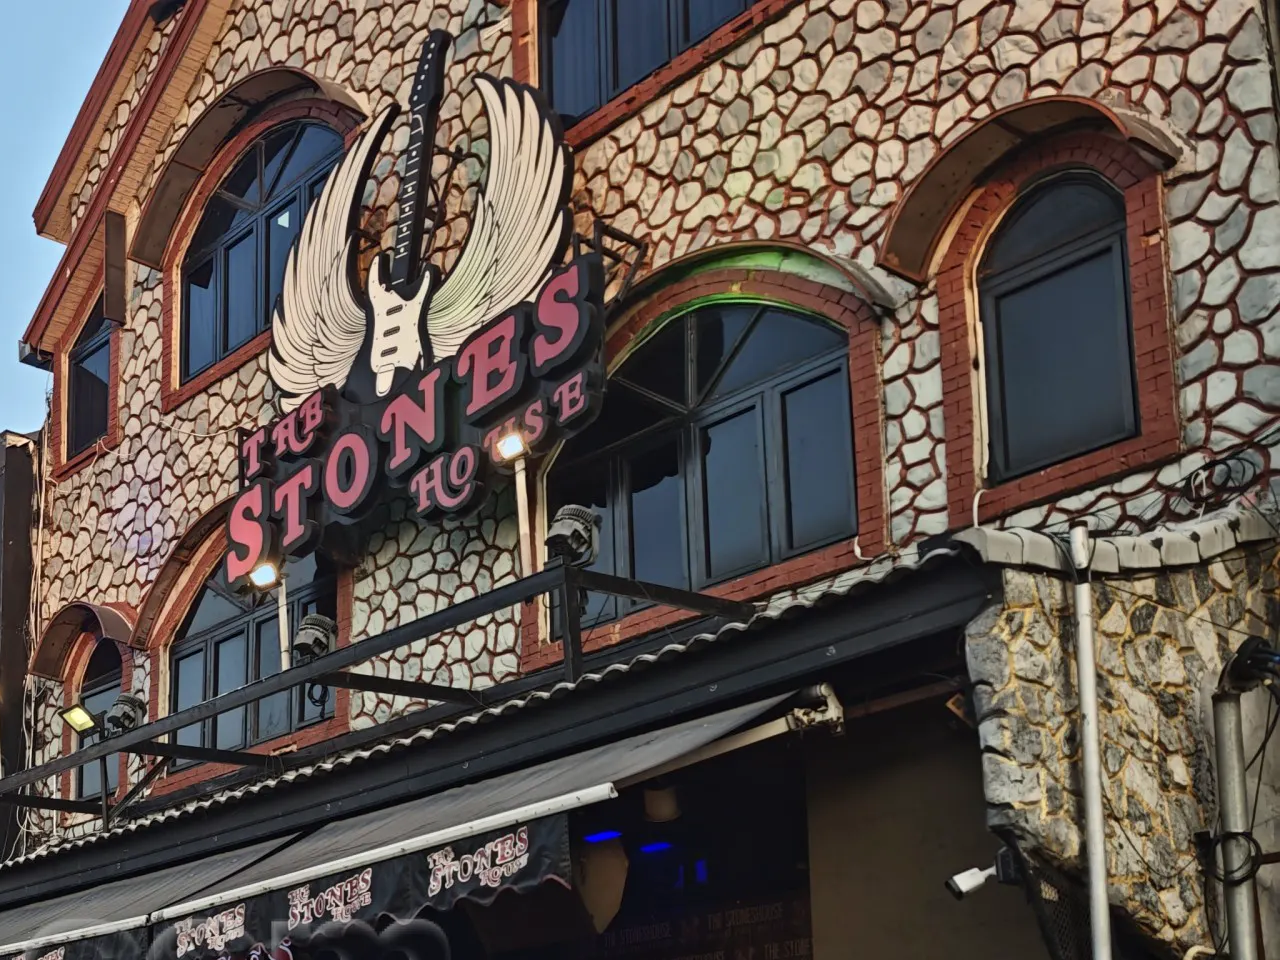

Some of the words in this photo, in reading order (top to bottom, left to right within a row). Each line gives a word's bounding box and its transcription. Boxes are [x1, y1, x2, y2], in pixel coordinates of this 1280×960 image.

[226, 264, 579, 584] STONES
[428, 826, 528, 898] STONES
[177, 903, 246, 958] STONES
[288, 868, 372, 930] STONES
